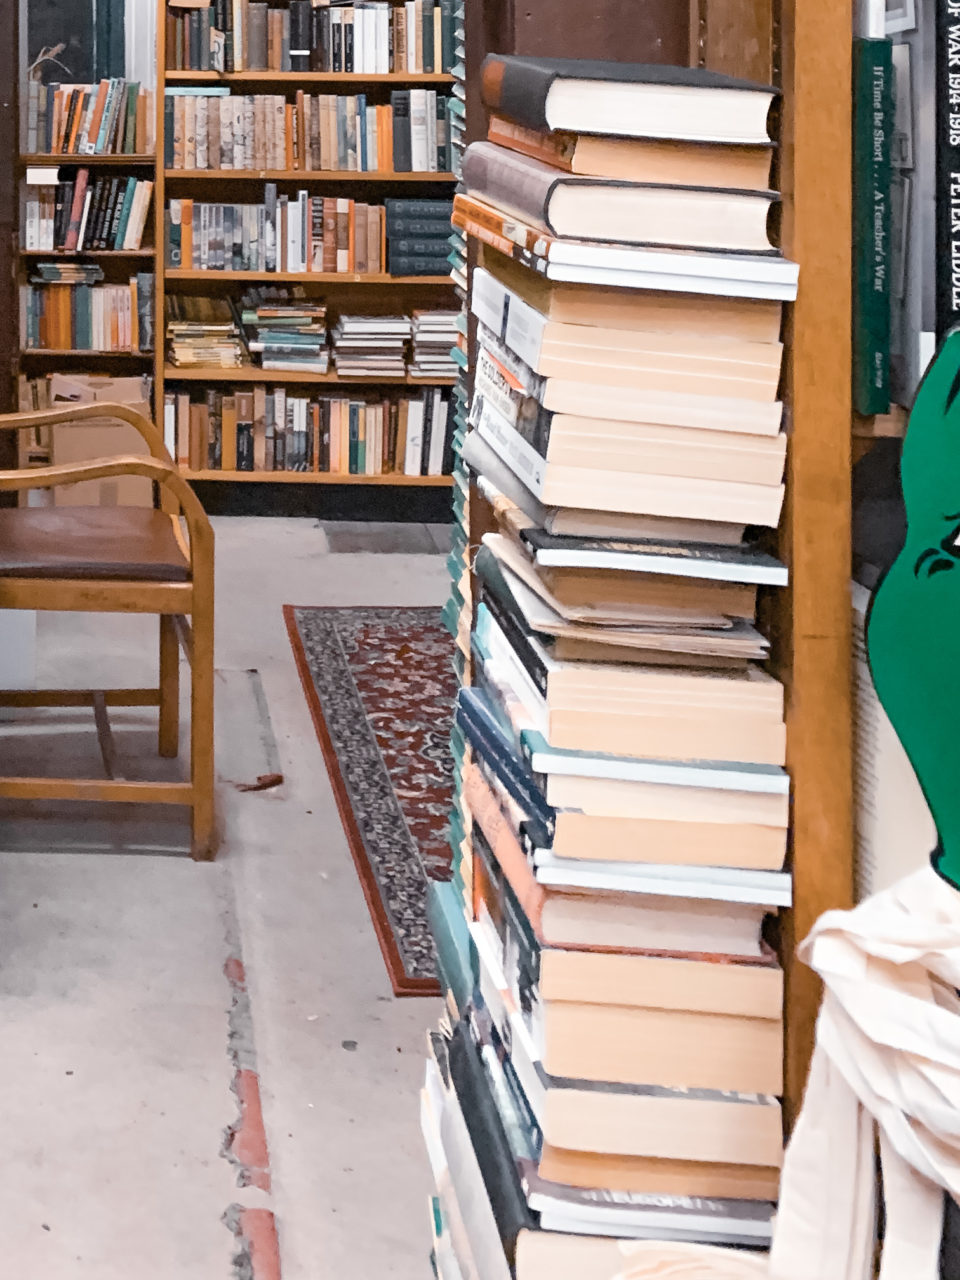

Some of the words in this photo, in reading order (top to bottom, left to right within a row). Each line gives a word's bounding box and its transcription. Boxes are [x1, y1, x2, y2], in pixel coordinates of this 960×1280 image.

[948, 23, 960, 68] WAR
[872, 66, 884, 76] If
[873, 78, 885, 109] Time
[949, 72, 960, 146] 1914-1918
[873, 111, 885, 126] Be
[873, 128, 885, 161] Short
[873, 190, 885, 200] A
[950, 172, 960, 237] PETER
[873, 203, 886, 261] Teacher's
[873, 264, 885, 292] War
[951, 241, 960, 311] LIDDLE
